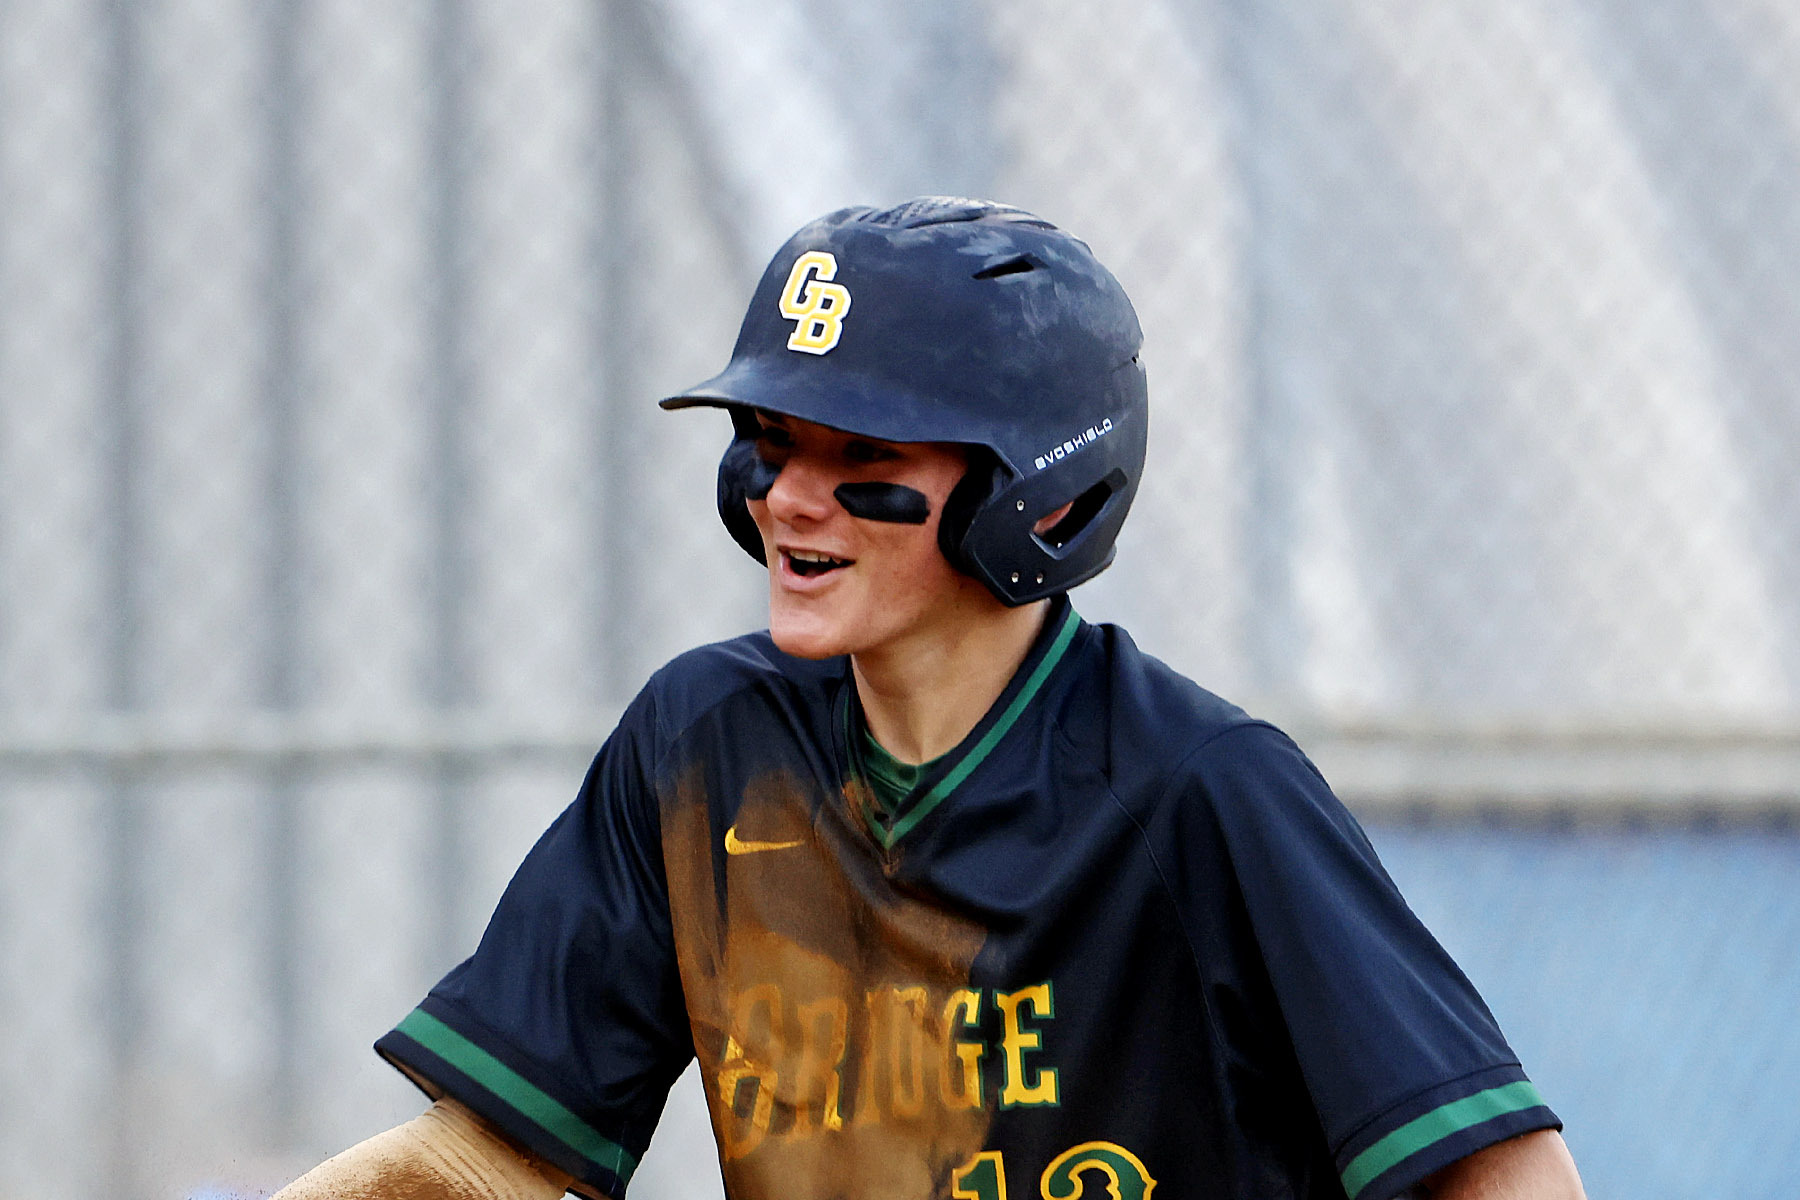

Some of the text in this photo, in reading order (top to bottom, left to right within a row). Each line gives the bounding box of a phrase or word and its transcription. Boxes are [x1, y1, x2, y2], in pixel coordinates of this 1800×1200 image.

[779, 251, 852, 355] GB
[1034, 417, 1113, 470] EVOSHIELD
[717, 981, 1061, 1162] BRIDGE
